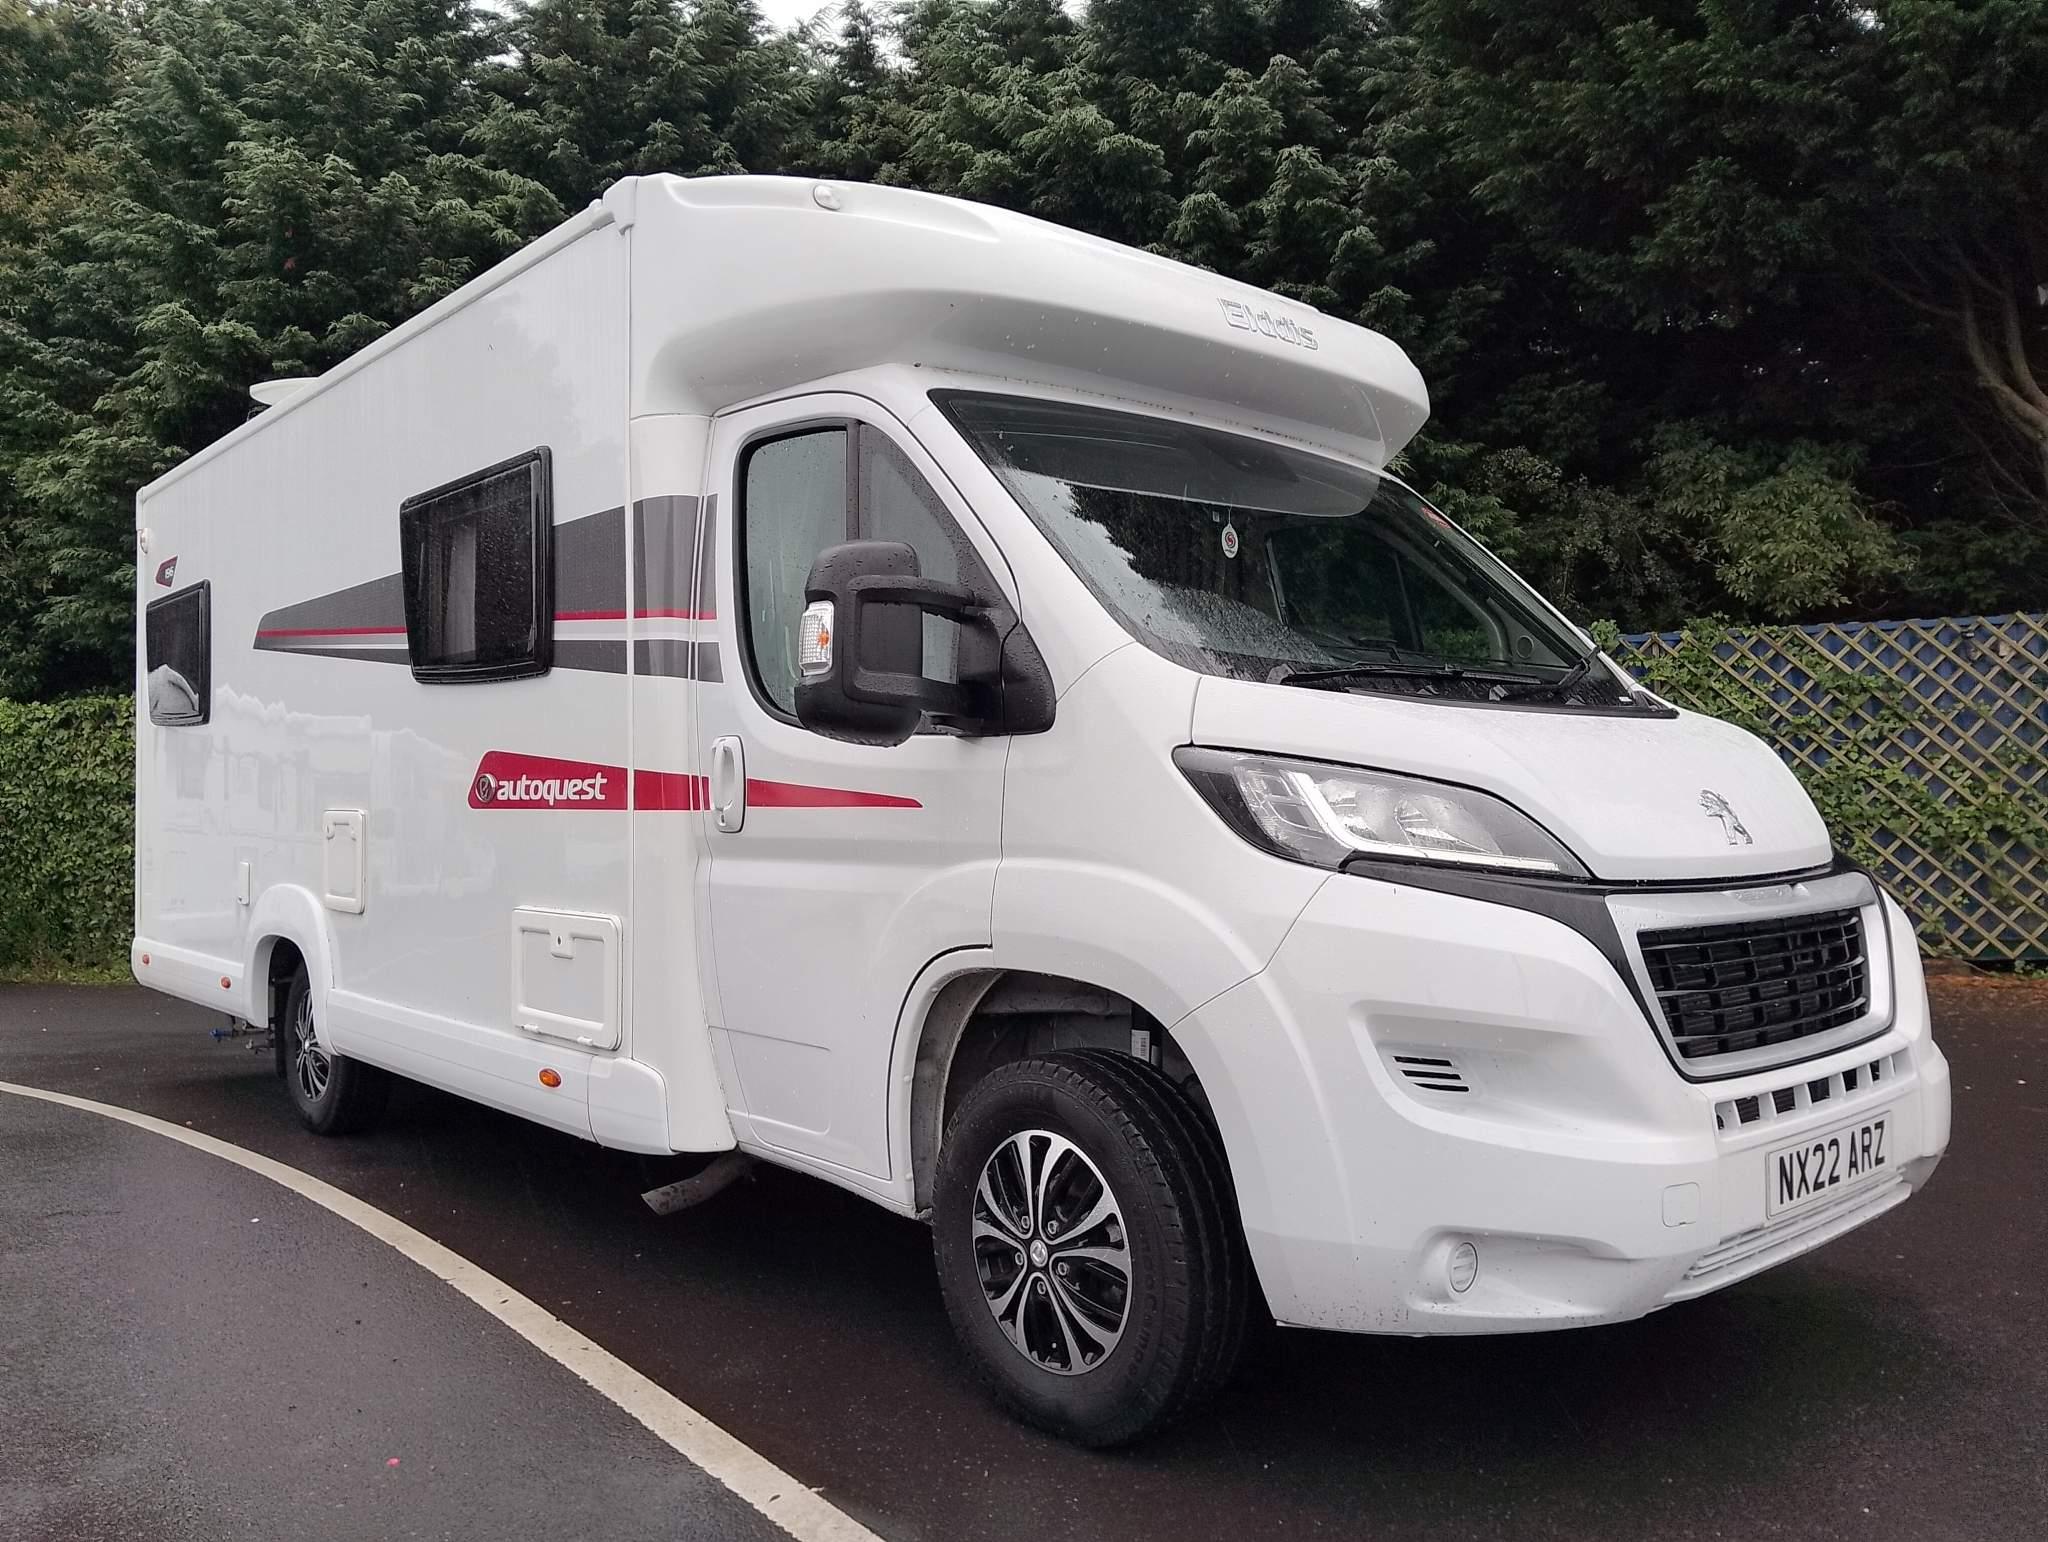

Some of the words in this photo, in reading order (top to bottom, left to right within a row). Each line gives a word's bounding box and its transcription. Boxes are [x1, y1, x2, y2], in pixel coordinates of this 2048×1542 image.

[1217, 297, 1319, 350] Elddis
[497, 772, 607, 806] autoquest
[1779, 1138, 1841, 1205] NX22
[1848, 1120, 1886, 1178] ARZ
